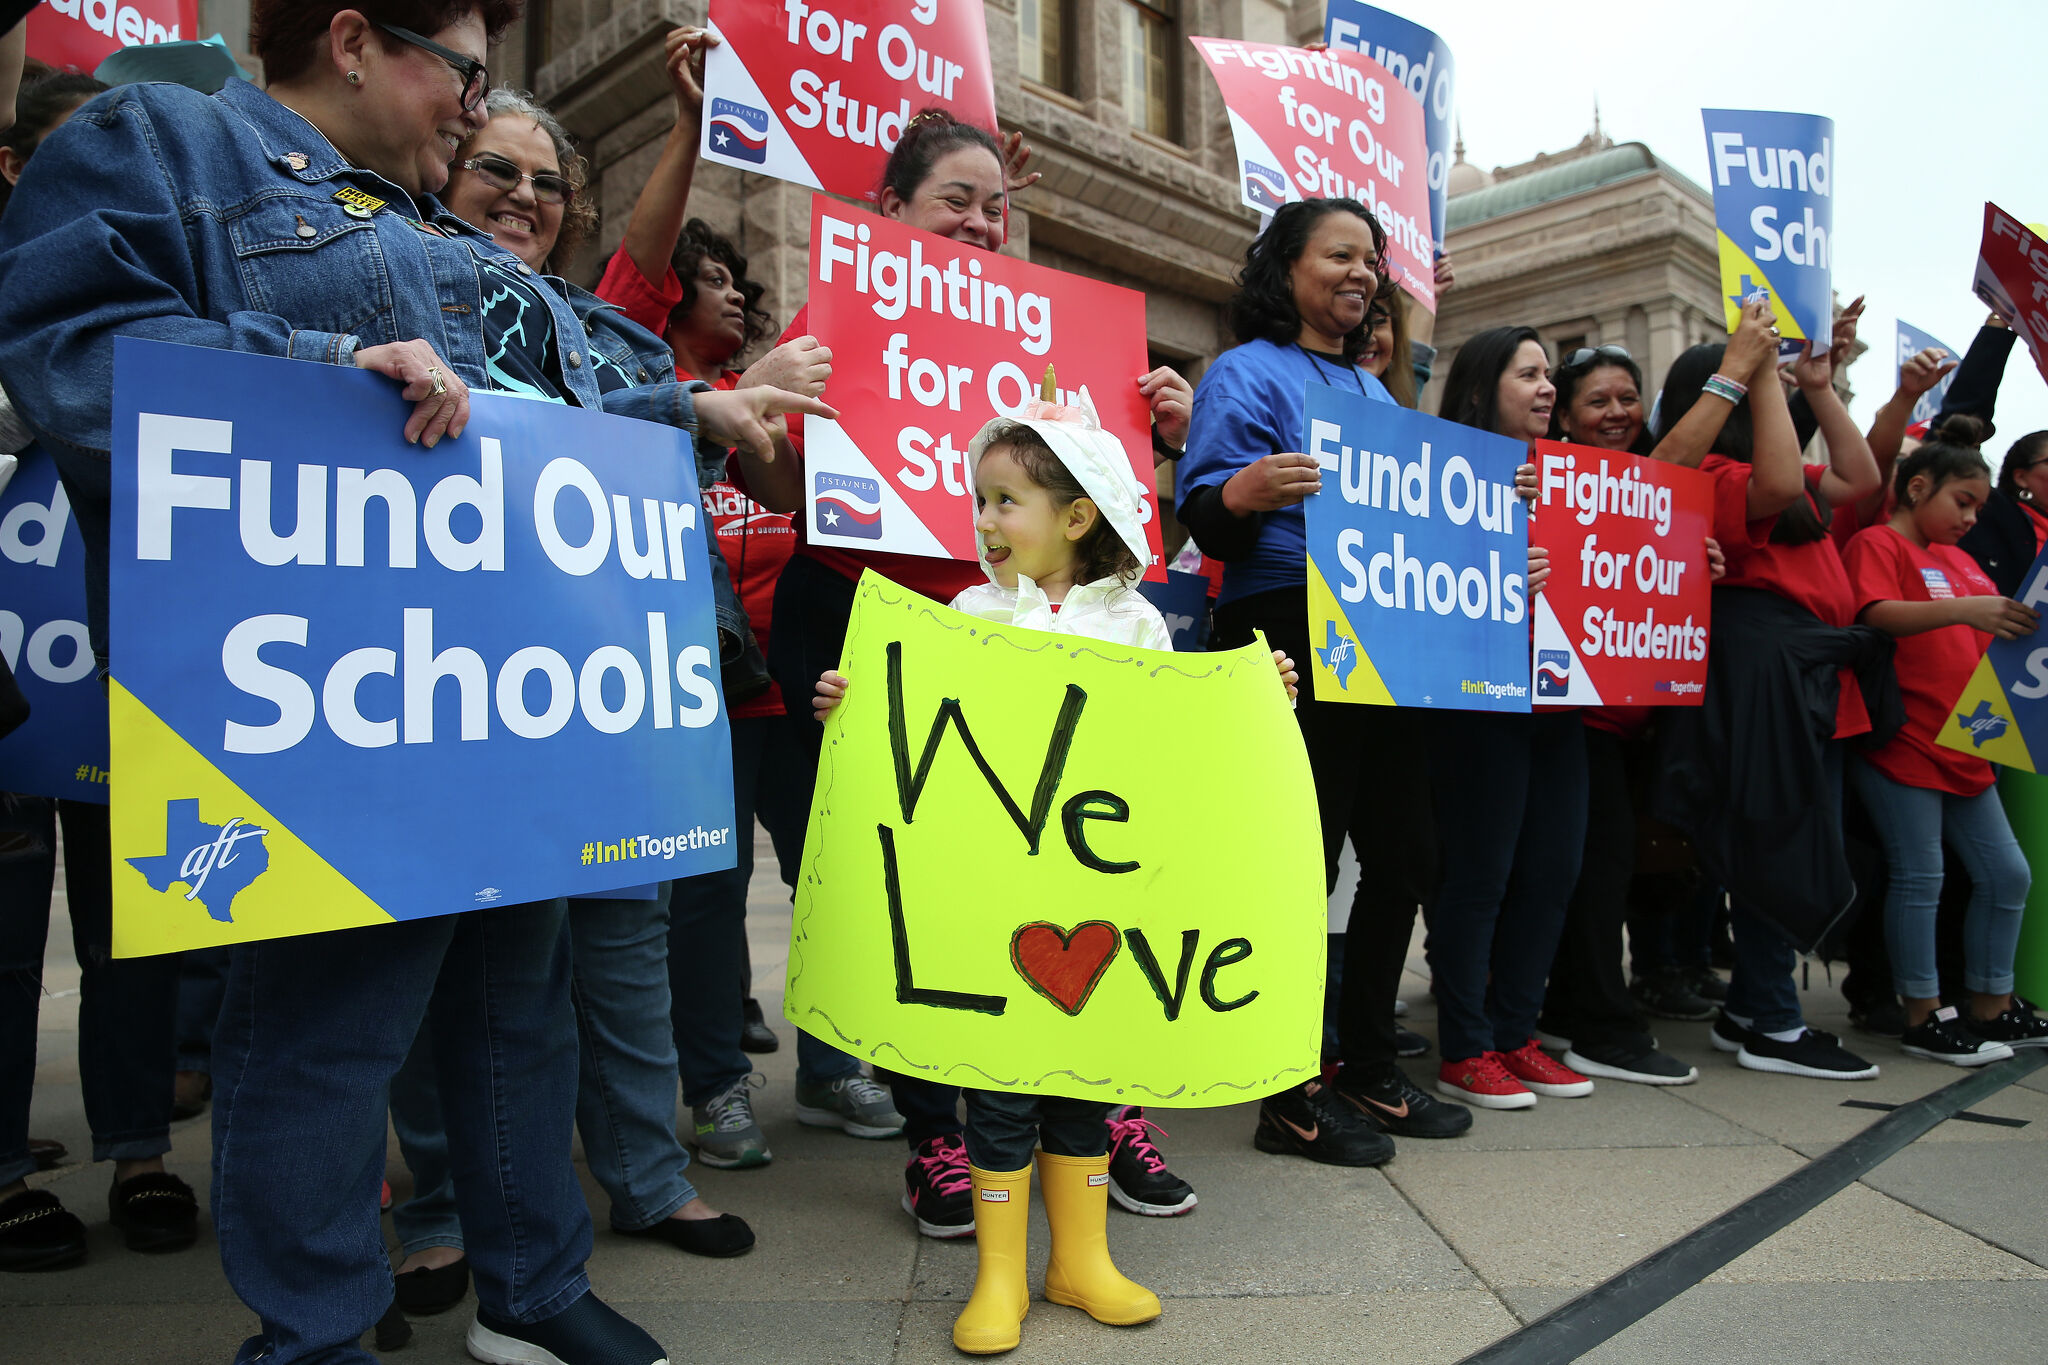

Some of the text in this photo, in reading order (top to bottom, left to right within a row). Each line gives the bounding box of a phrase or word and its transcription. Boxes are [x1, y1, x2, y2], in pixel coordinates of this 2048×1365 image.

[785, 0, 964, 101] for Our
[1202, 41, 1385, 125] Fighting
[717, 102, 764, 121] TSTA/NEA
[785, 69, 910, 154] Stud
[1278, 86, 1340, 145] for
[1348, 119, 1404, 188] Our
[1711, 132, 1830, 197] Fund
[1294, 145, 1432, 269] Students
[819, 215, 1052, 355] Fighting
[882, 333, 974, 412] for
[137, 412, 505, 572] Fund
[534, 457, 696, 581] Our
[821, 476, 875, 491] TSTA/NEA
[1311, 419, 1521, 535] Fund Our
[1542, 454, 1672, 537] Fighting
[1336, 528, 1525, 624] Schools
[1581, 533, 1686, 596] for Our
[1330, 634, 1357, 675] aft
[1580, 605, 1707, 662] Students
[222, 607, 720, 755] Schools
[1461, 680, 1527, 699] #InItTogether
[887, 641, 1141, 874] We
[180, 816, 269, 901] aft
[580, 825, 729, 866] #InItTogether
